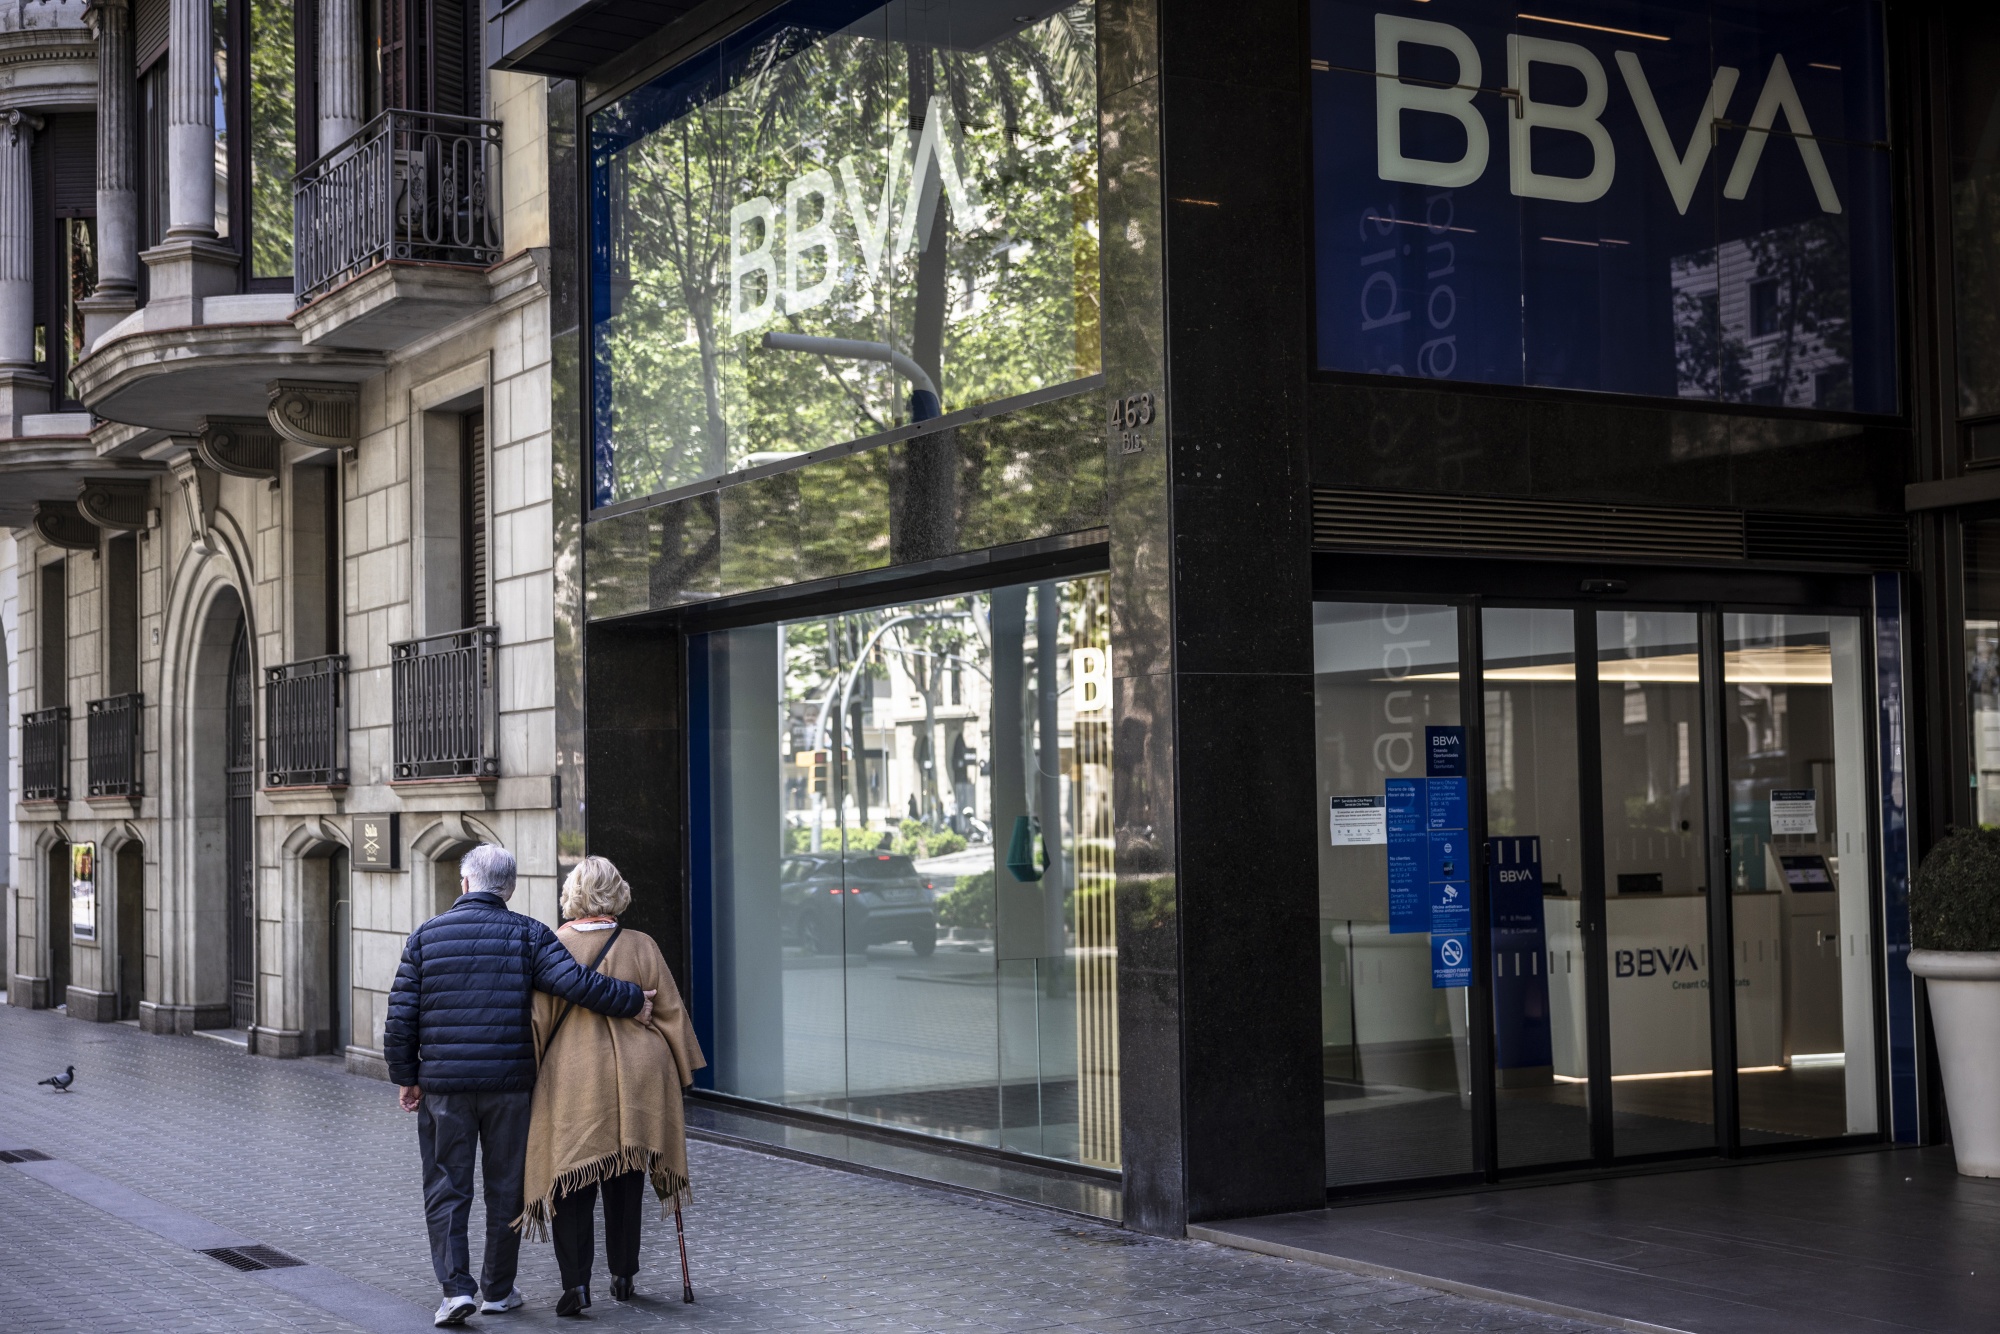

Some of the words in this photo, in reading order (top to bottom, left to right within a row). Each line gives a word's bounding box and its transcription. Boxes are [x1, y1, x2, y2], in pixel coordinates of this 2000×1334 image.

[1374, 13, 1842, 216] BBVA
[730, 96, 980, 338] BBVA
[1111, 392, 1154, 431] 463
[1073, 645, 1113, 712] B
[1433, 735, 1459, 745] BBVA
[1500, 869, 1532, 882] BBVA
[1616, 945, 1698, 978] BBVA
[1672, 980, 1699, 990] Creant
